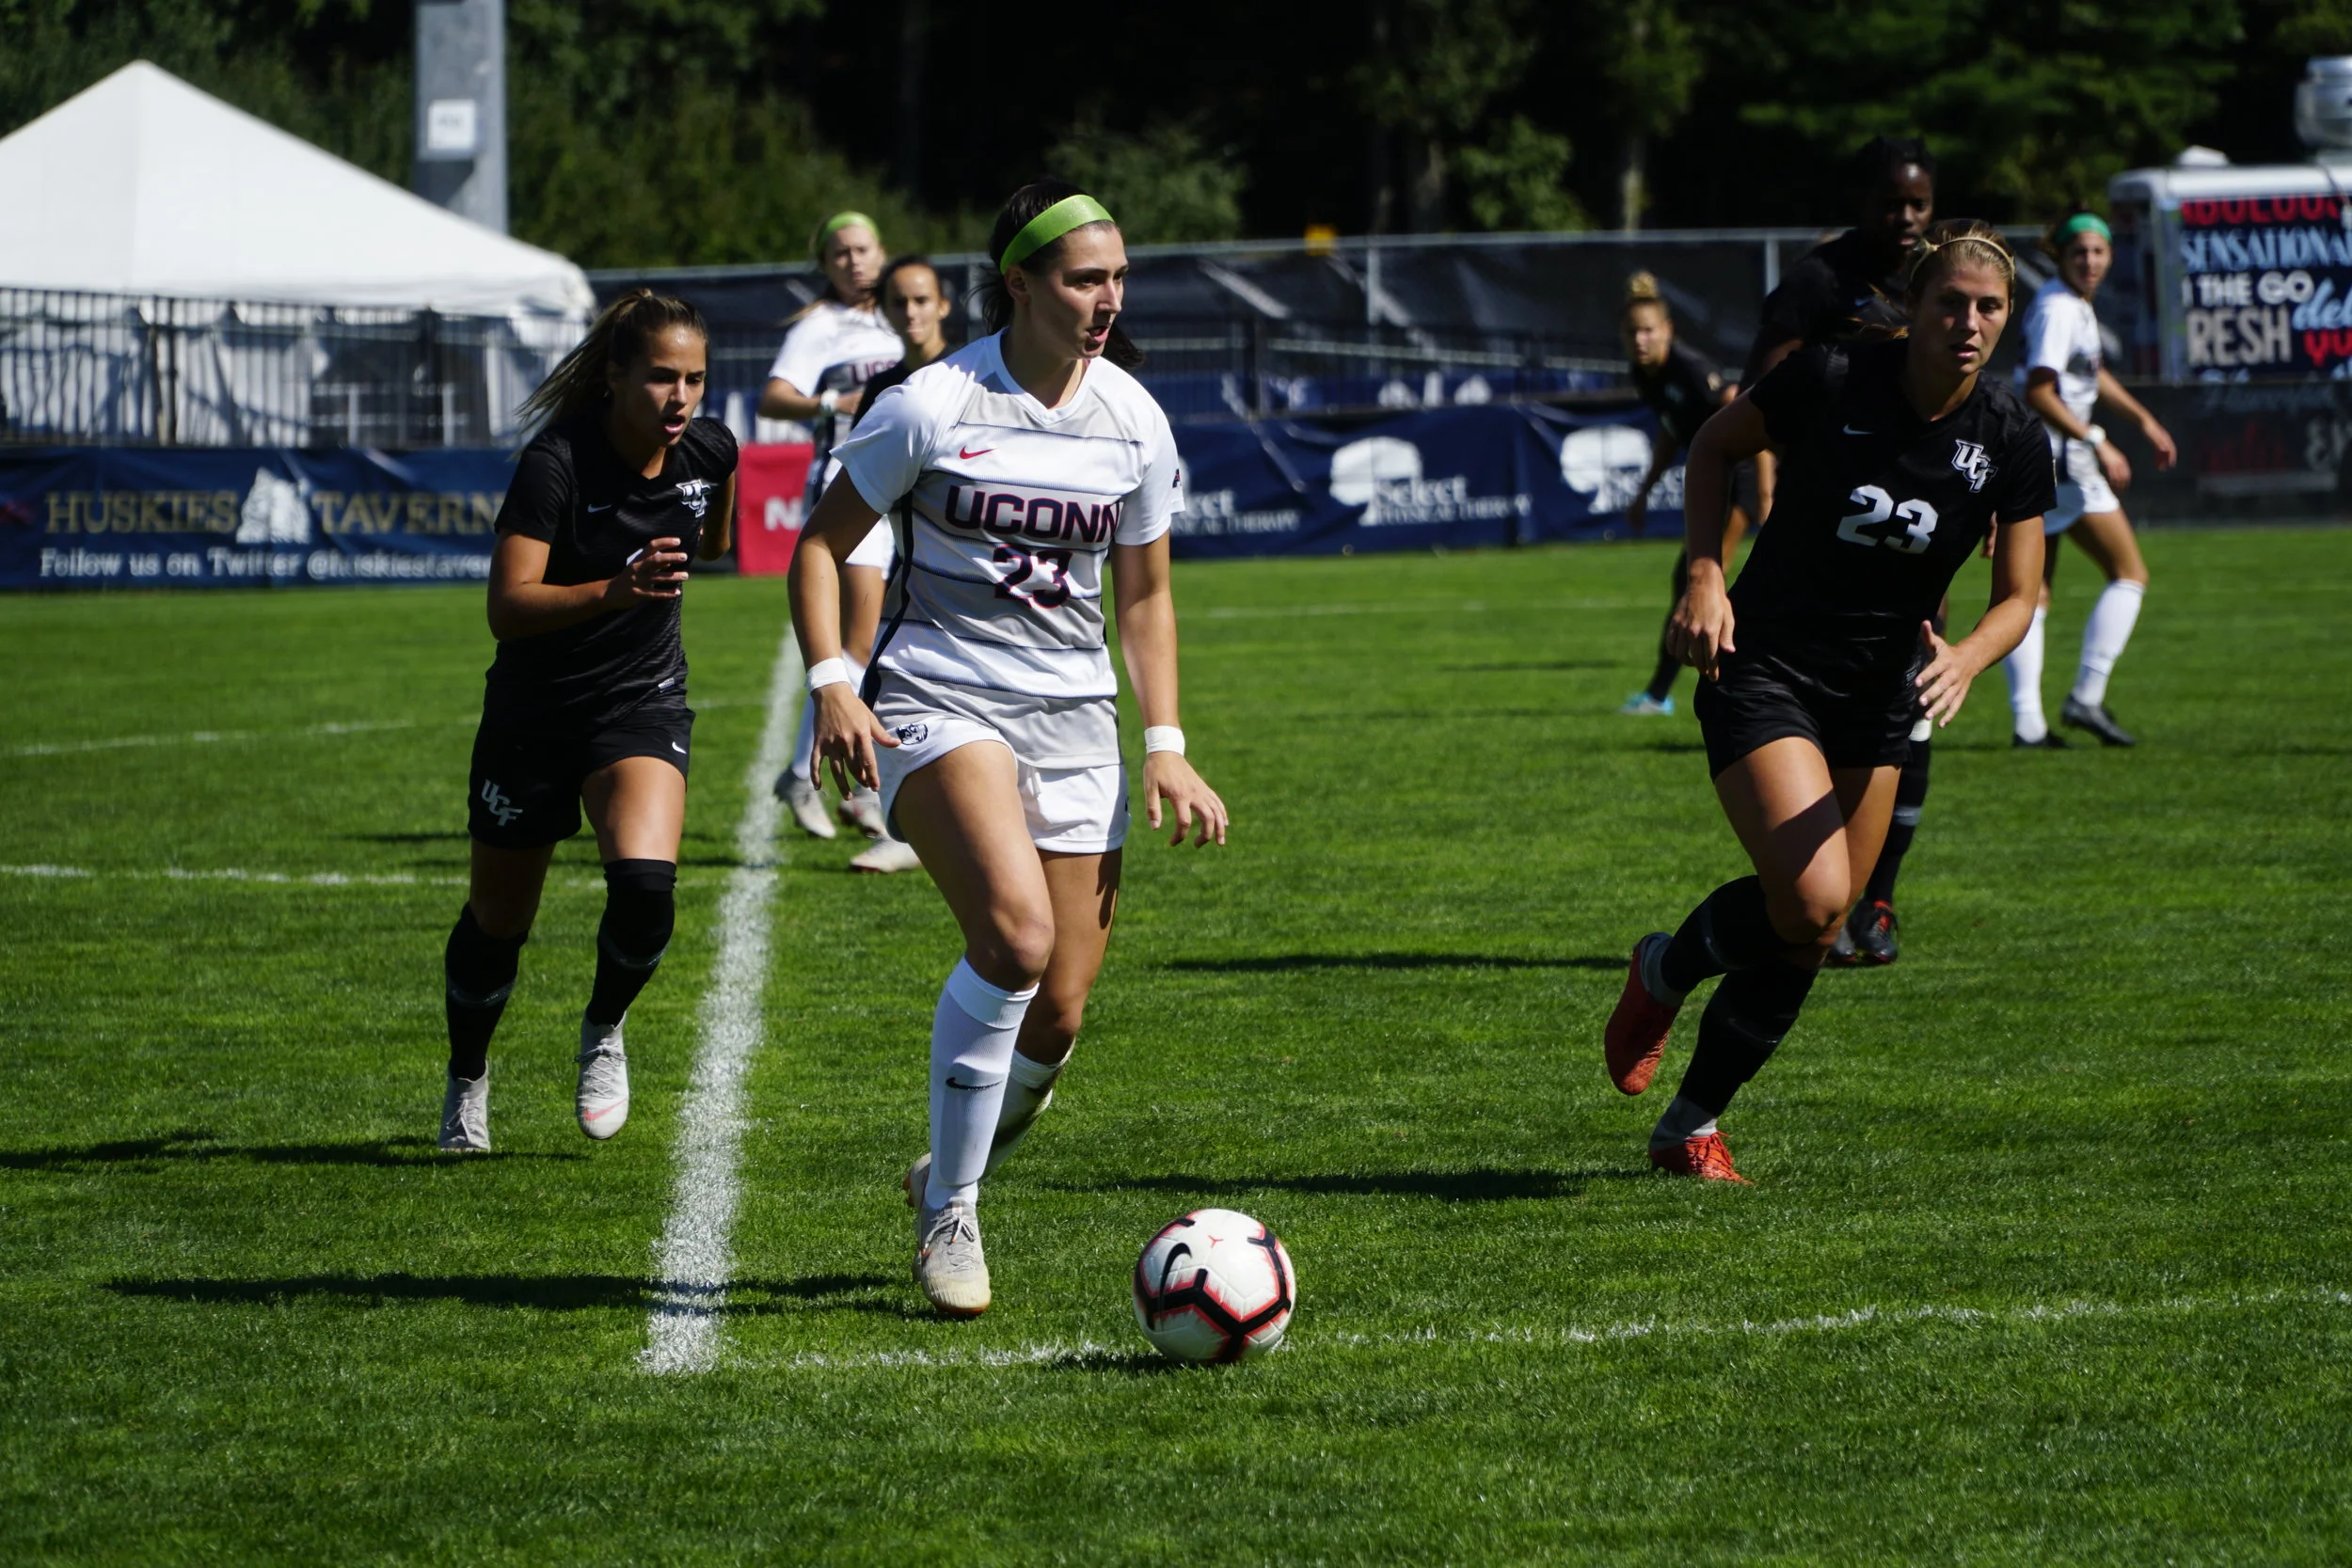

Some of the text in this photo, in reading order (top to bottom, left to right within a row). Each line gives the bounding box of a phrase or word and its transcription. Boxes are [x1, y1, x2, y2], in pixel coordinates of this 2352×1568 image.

[2199, 273, 2254, 308] THE
[2259, 270, 2314, 305] GO
[45, 490, 240, 534] HUSKIES
[945, 485, 1120, 543] UCONN
[1836, 484, 1939, 555] 23
[40, 547, 121, 577] Follow
[130, 553, 161, 576] us
[167, 552, 200, 576] on
[207, 546, 303, 577] Twitter
[993, 544, 1073, 610] 23
[481, 779, 523, 827] UCF
